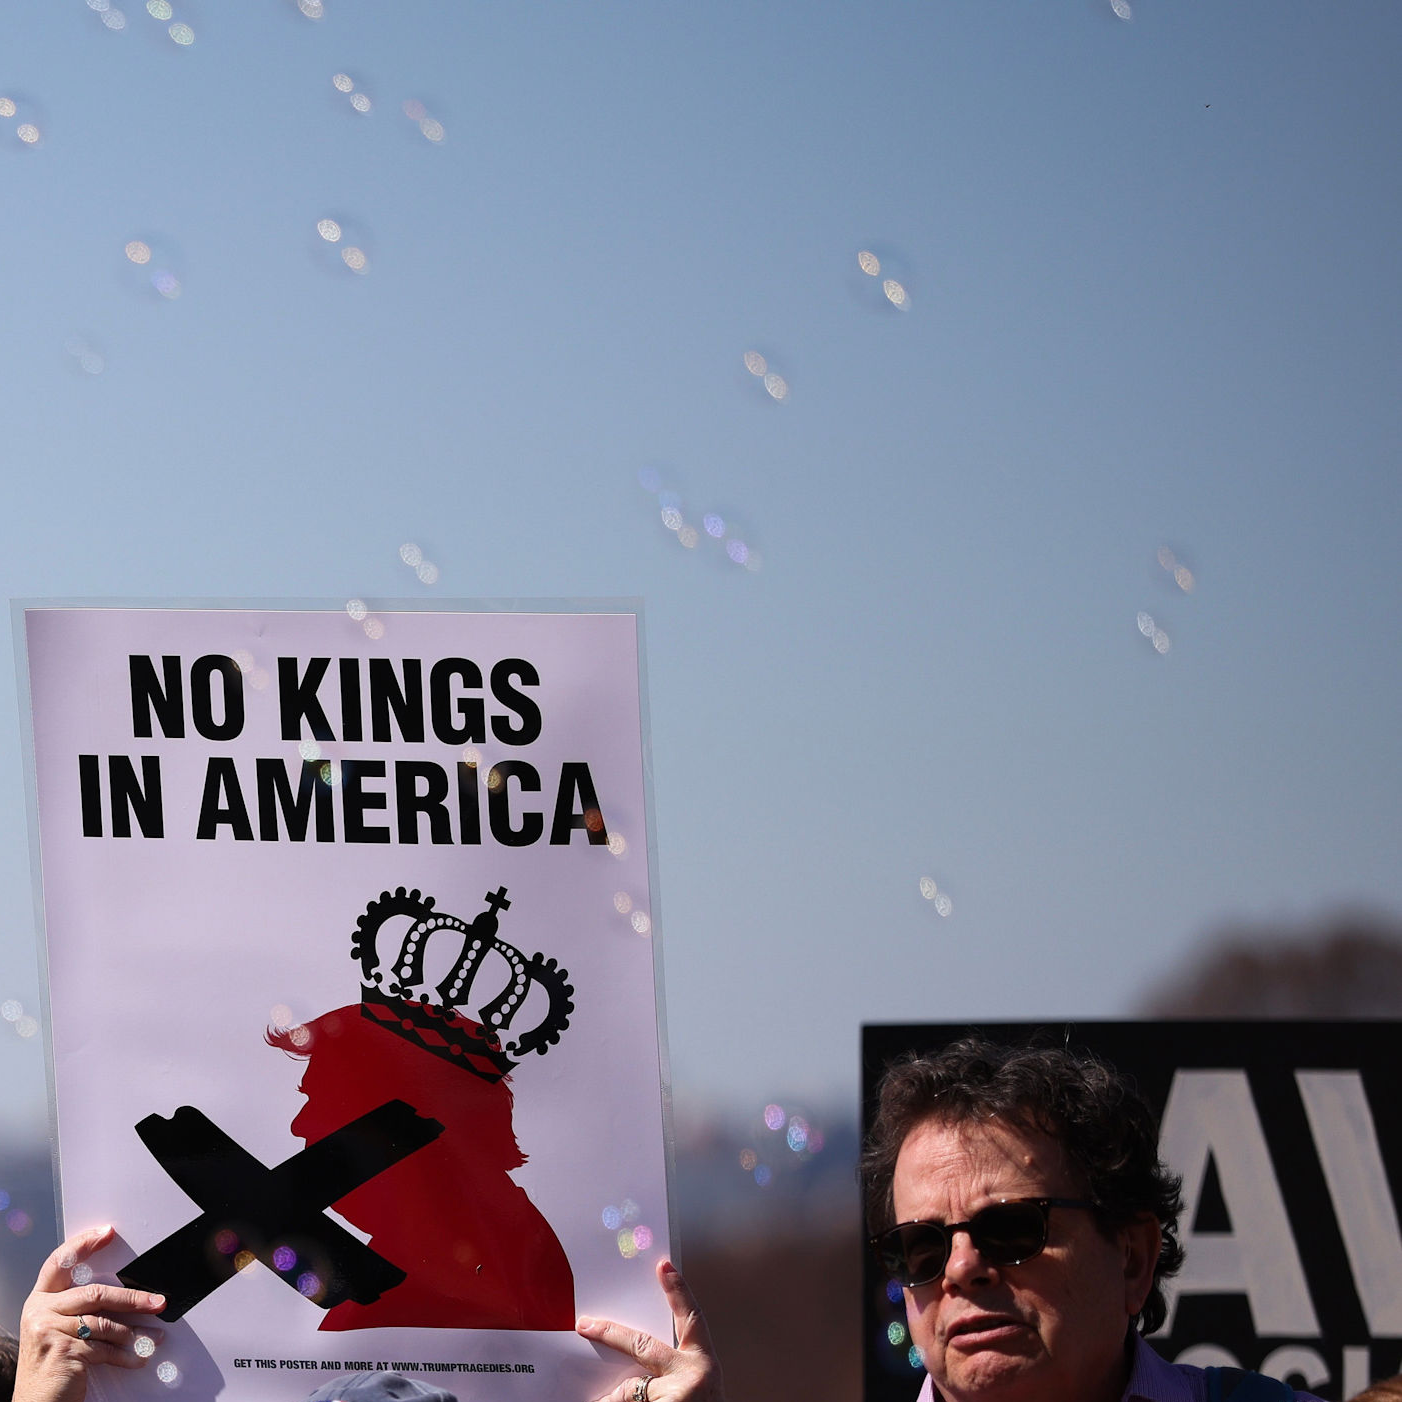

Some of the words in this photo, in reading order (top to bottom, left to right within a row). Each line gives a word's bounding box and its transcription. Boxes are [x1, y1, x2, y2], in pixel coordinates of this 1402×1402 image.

[129, 654, 245, 742] NO
[278, 657, 543, 747] KINGS
[79, 754, 165, 839] IN
[196, 756, 611, 846] AMERICA
[233, 1358, 253, 1369] GET
[254, 1359, 277, 1370] THIS
[279, 1359, 319, 1371] POSTER
[320, 1361, 342, 1371] AND
[343, 1361, 374, 1372] MORE
[375, 1361, 390, 1372] AT
[391, 1362, 535, 1374] WWW.TRUMPTRAGEDIES.ORG
